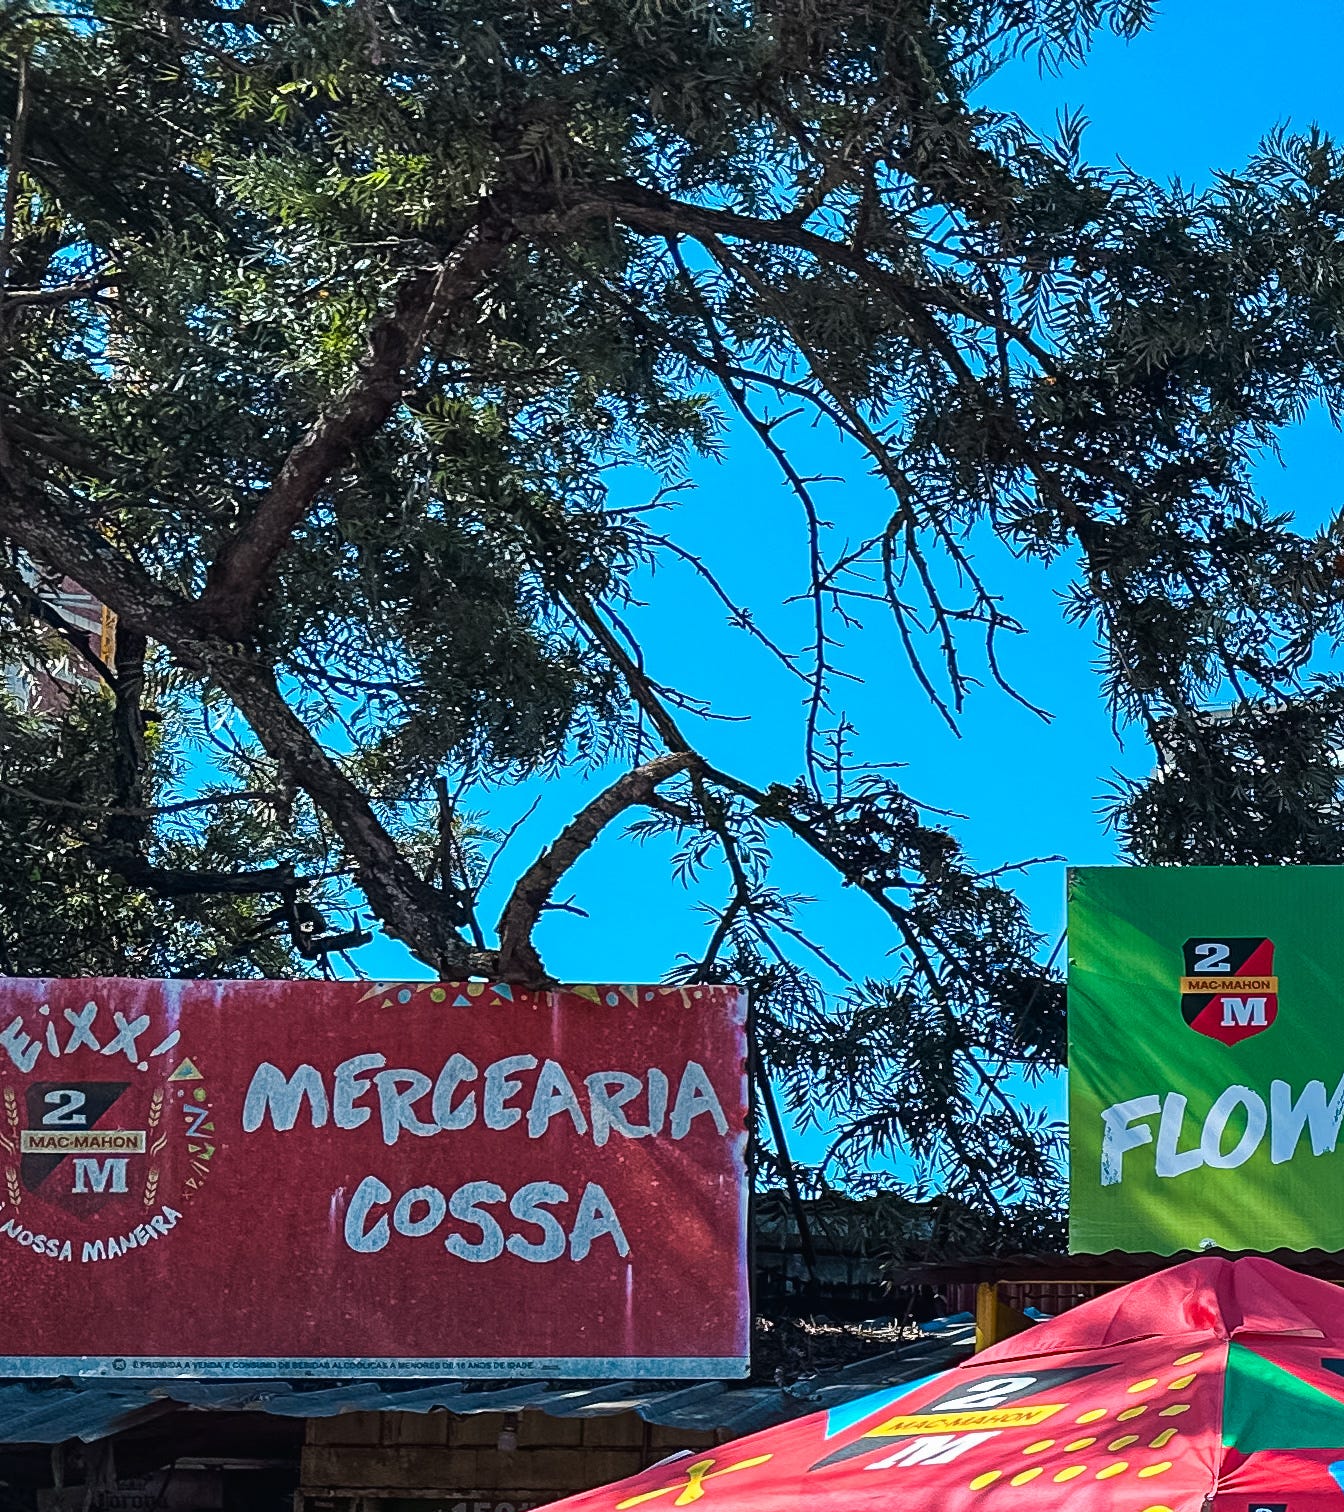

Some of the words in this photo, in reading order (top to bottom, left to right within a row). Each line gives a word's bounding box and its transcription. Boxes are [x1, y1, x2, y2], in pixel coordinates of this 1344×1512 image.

[1194, 943, 1231, 972] 2
[1220, 997, 1268, 1027] M
[42, 1089, 87, 1125] 2
[242, 1053, 729, 1147] MERCEARIA
[71, 1158, 130, 1194] M
[81, 1205, 183, 1263] MANEIRA
[345, 1175, 631, 1262] COSSA
[931, 1377, 1037, 1411] 2
[863, 1431, 1004, 1471] M
